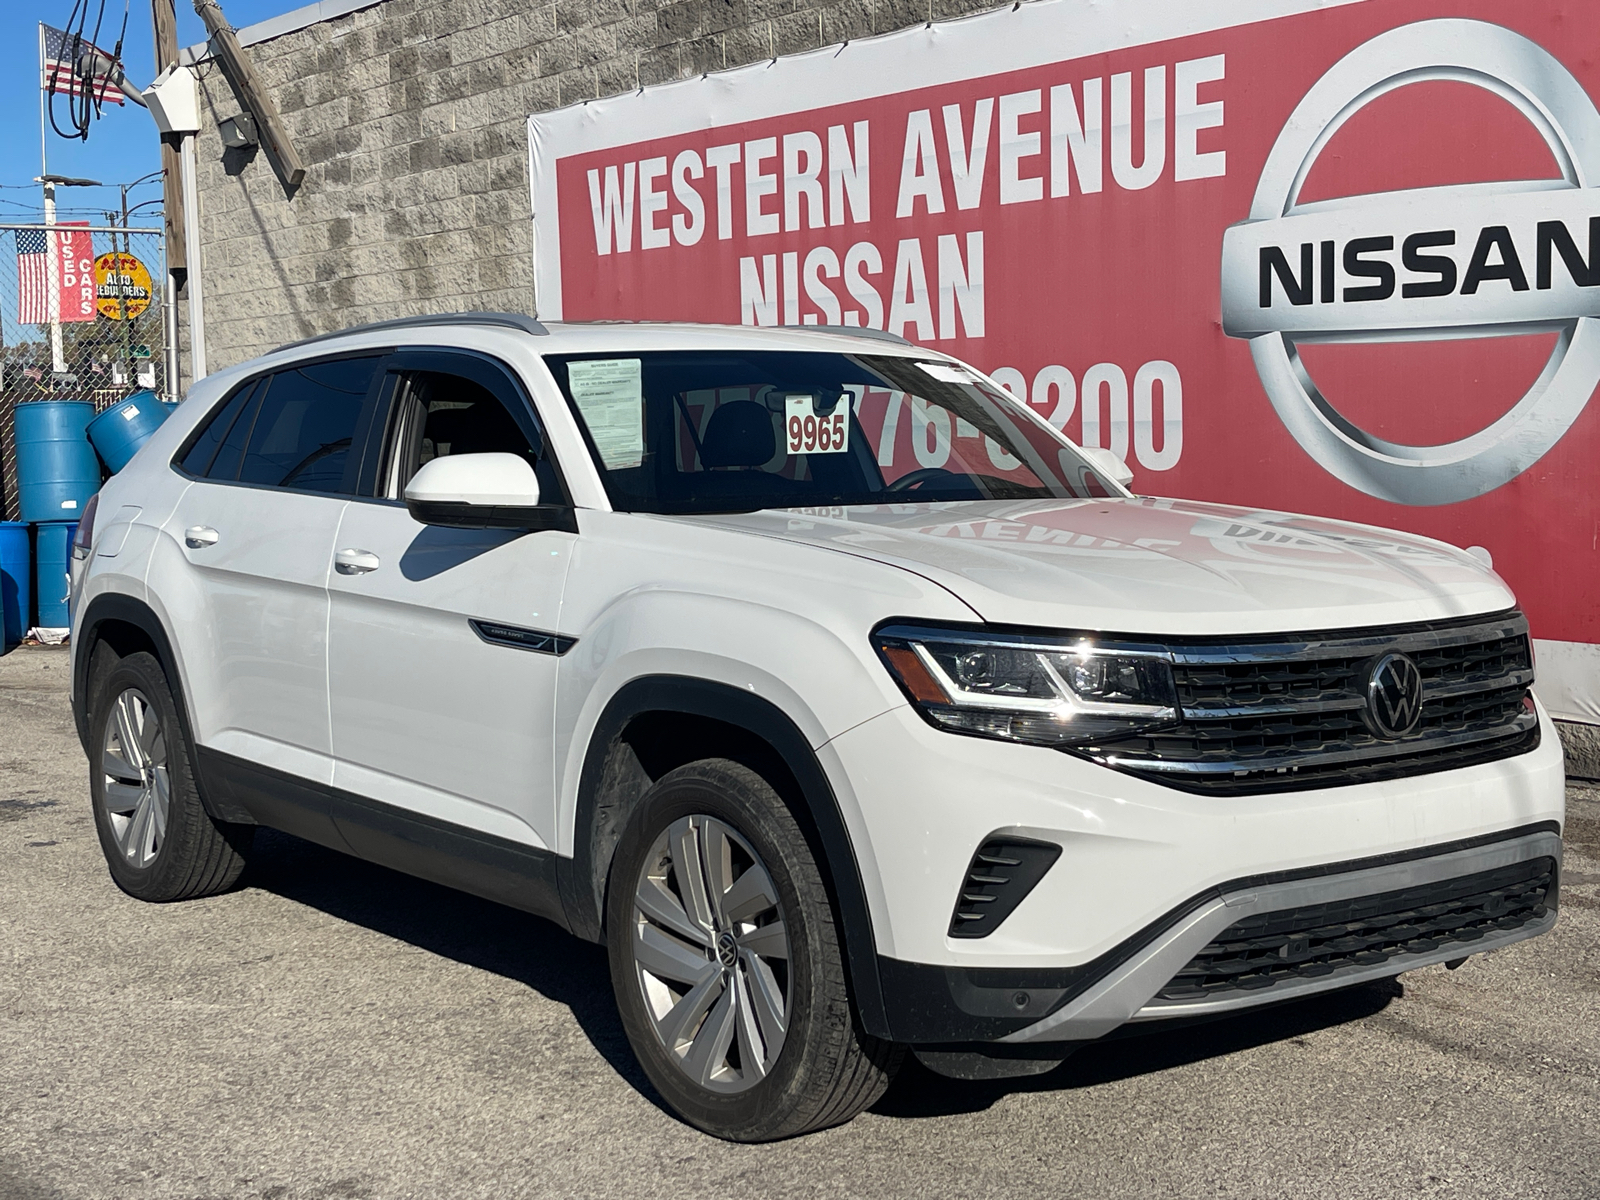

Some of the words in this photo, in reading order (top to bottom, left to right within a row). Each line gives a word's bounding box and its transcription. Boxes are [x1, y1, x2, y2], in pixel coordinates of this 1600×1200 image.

[587, 121, 871, 256] WESTERN
[896, 54, 1227, 218] AVENUE
[60, 231, 77, 288] USED
[79, 258, 93, 315] CARS
[739, 230, 986, 341] NISSAN
[1258, 216, 1600, 308] NISSAN
[788, 414, 845, 453] 9965
